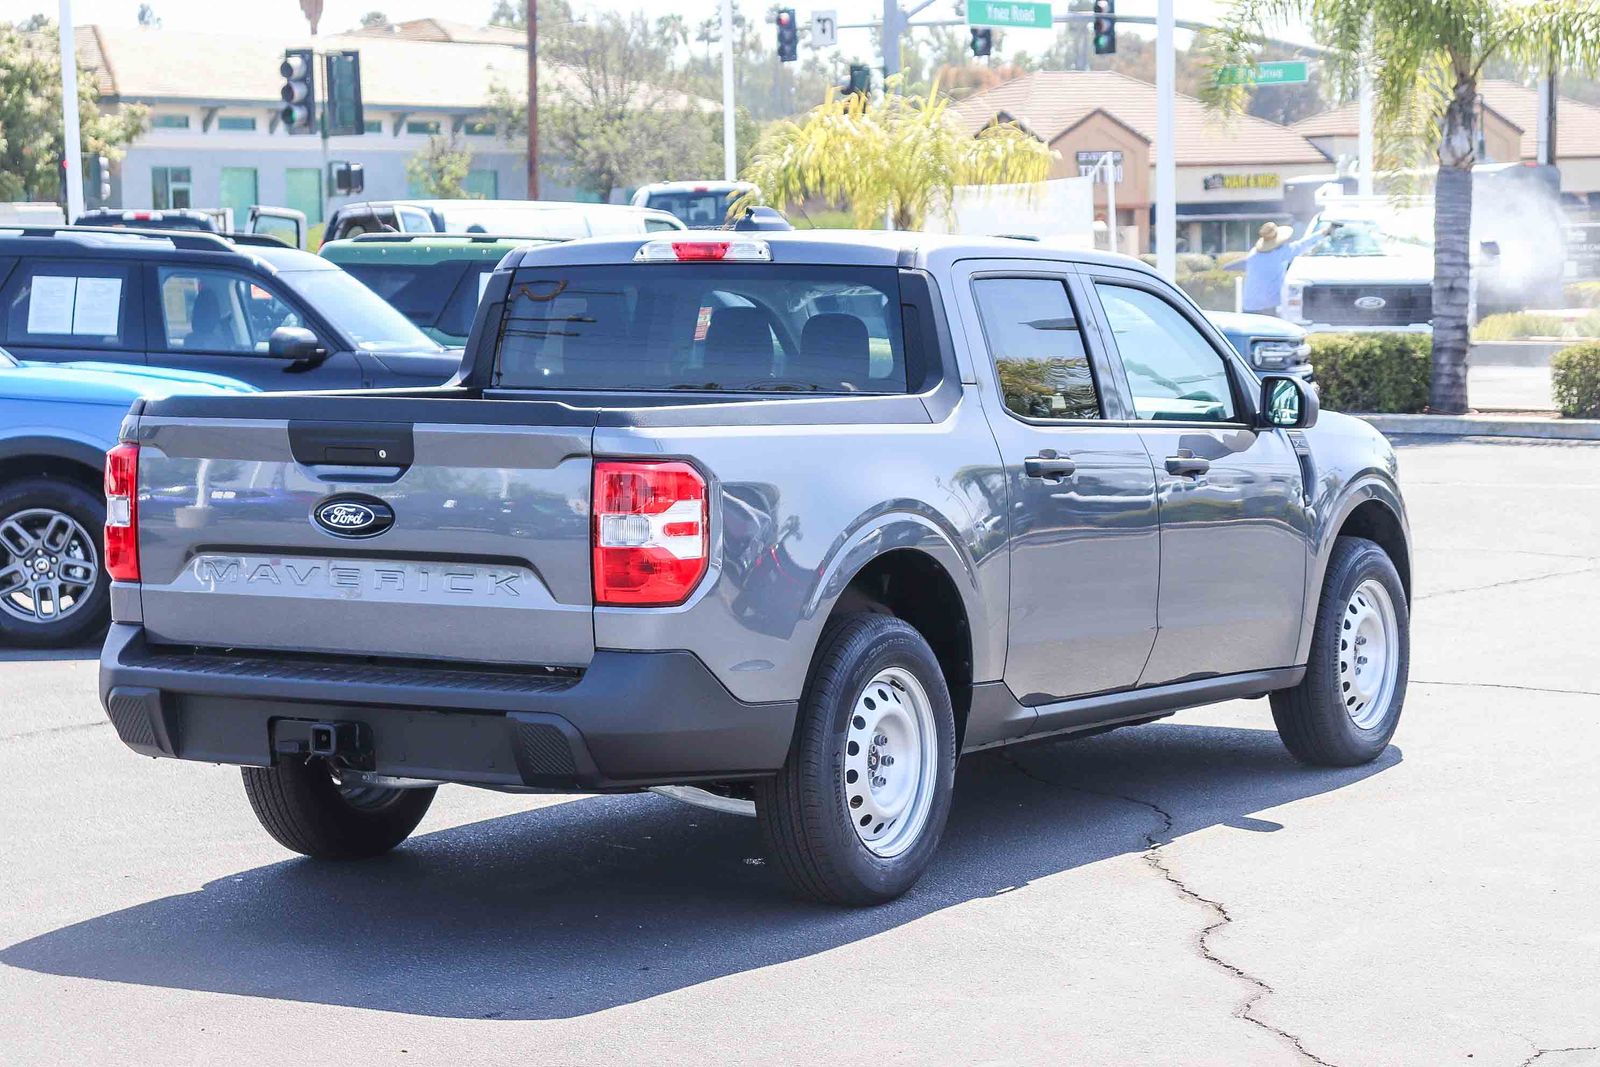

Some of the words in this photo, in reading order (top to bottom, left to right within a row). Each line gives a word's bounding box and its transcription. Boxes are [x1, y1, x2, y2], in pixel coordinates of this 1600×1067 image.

[1011, 4, 1036, 21] Road
[329, 505, 367, 526] Ford
[202, 560, 521, 599] MAVERICK
